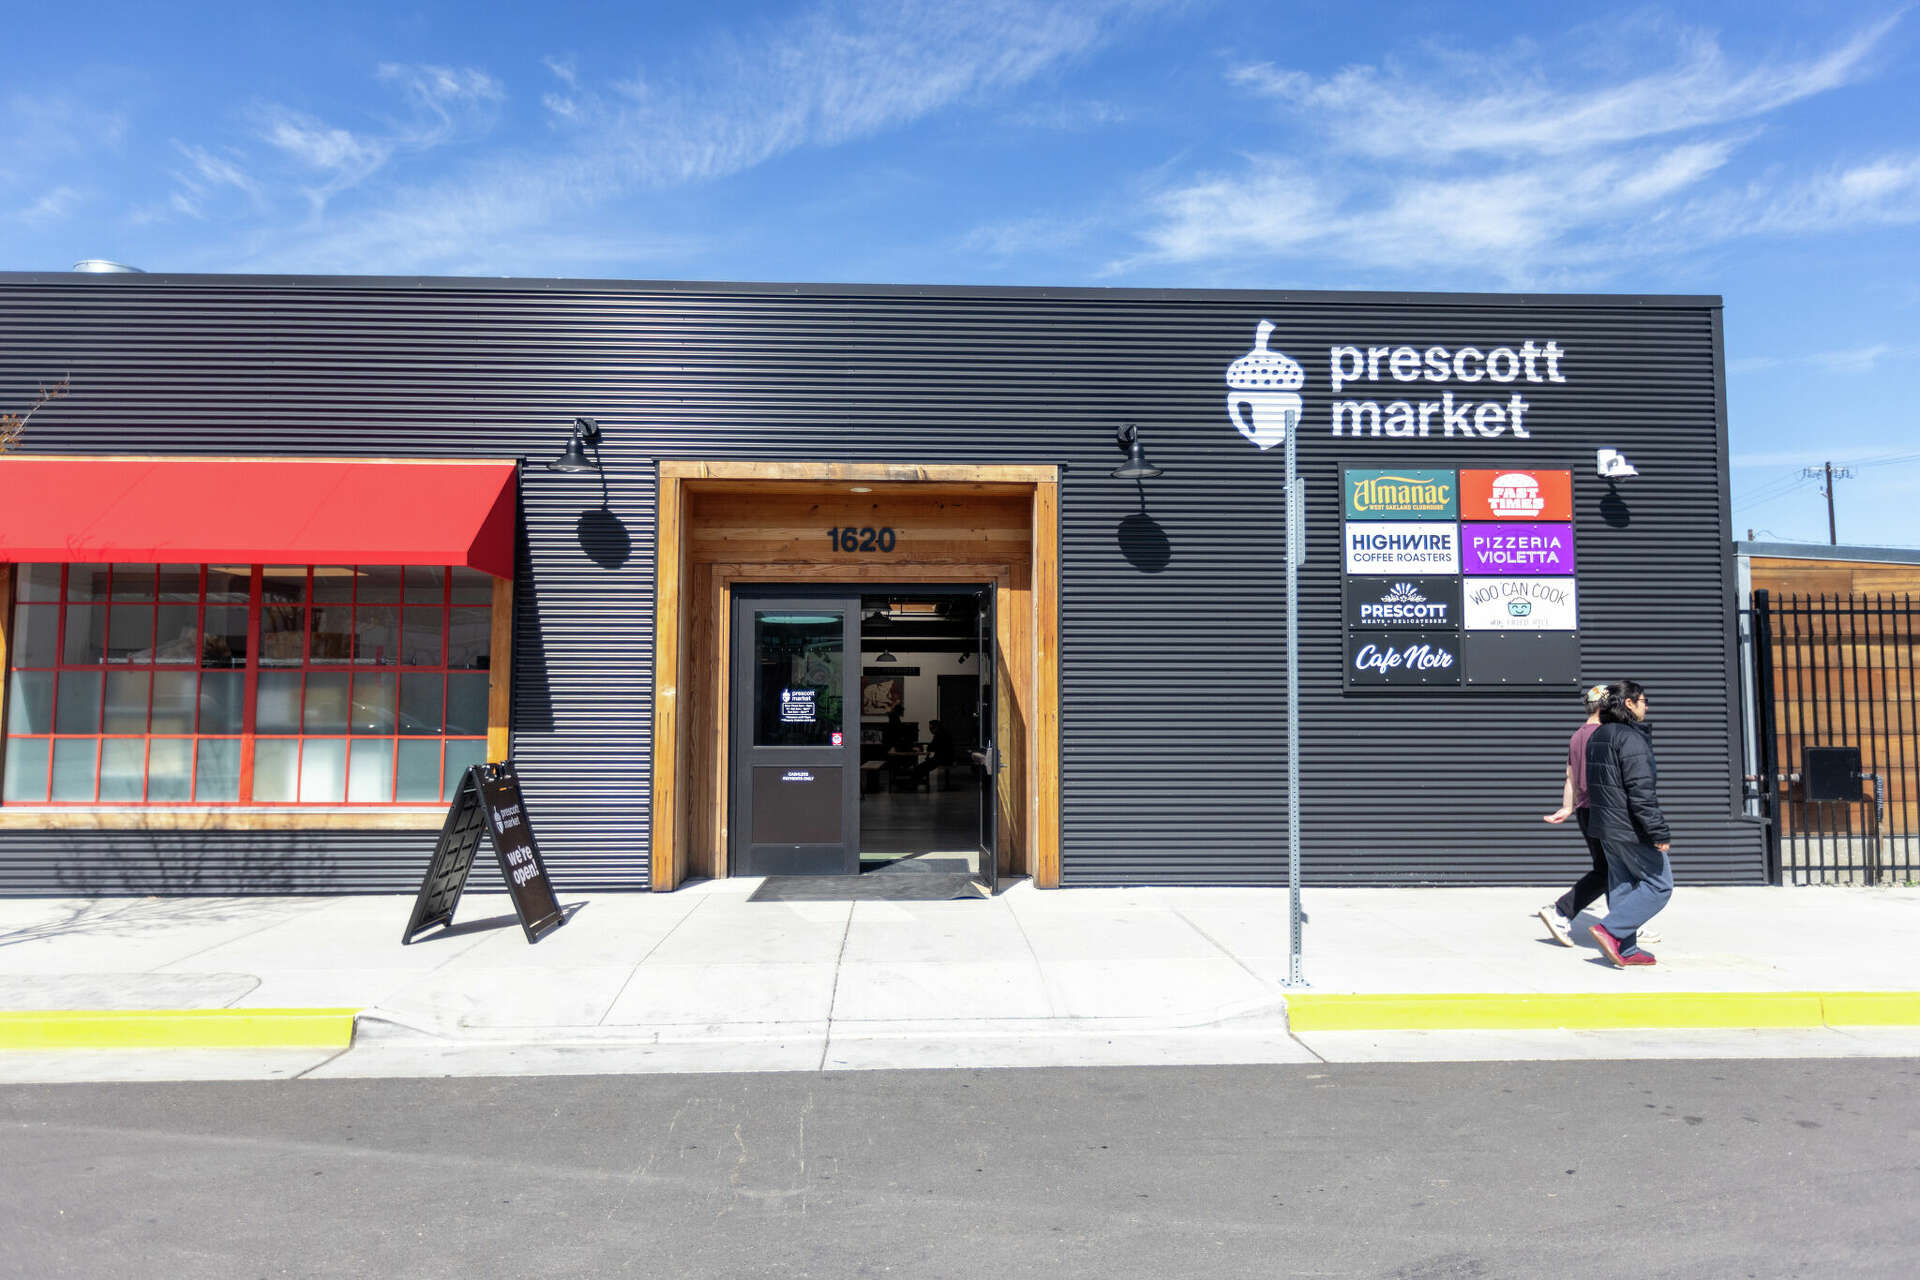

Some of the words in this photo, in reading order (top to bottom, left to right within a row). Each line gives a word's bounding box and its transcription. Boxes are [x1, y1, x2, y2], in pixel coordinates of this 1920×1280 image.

[1330, 340, 1567, 393] prescott
[1330, 391, 1531, 438] market
[1352, 476, 1451, 511] Almanac
[1492, 486, 1540, 499] FAST
[1488, 497, 1545, 510] TIMES
[826, 527, 897, 553] 1620
[1352, 534, 1451, 550] HIGHWIRE
[1473, 537, 1561, 549] PIZZERIA
[1353, 553, 1394, 562] COFFEE
[1397, 553, 1452, 562] ROASTERS
[1477, 551, 1560, 564] VIOLETTA
[1469, 585, 1499, 605] WOO
[1502, 582, 1528, 596] CAN
[1531, 583, 1569, 606] COOK
[1361, 604, 1448, 618] PRESCOTT
[1356, 645, 1402, 674] Cafe
[1403, 645, 1453, 670] Noir
[500, 804, 520, 820] prescott
[503, 817, 520, 828] market
[507, 845, 533, 867] we're
[513, 858, 540, 887] open!
